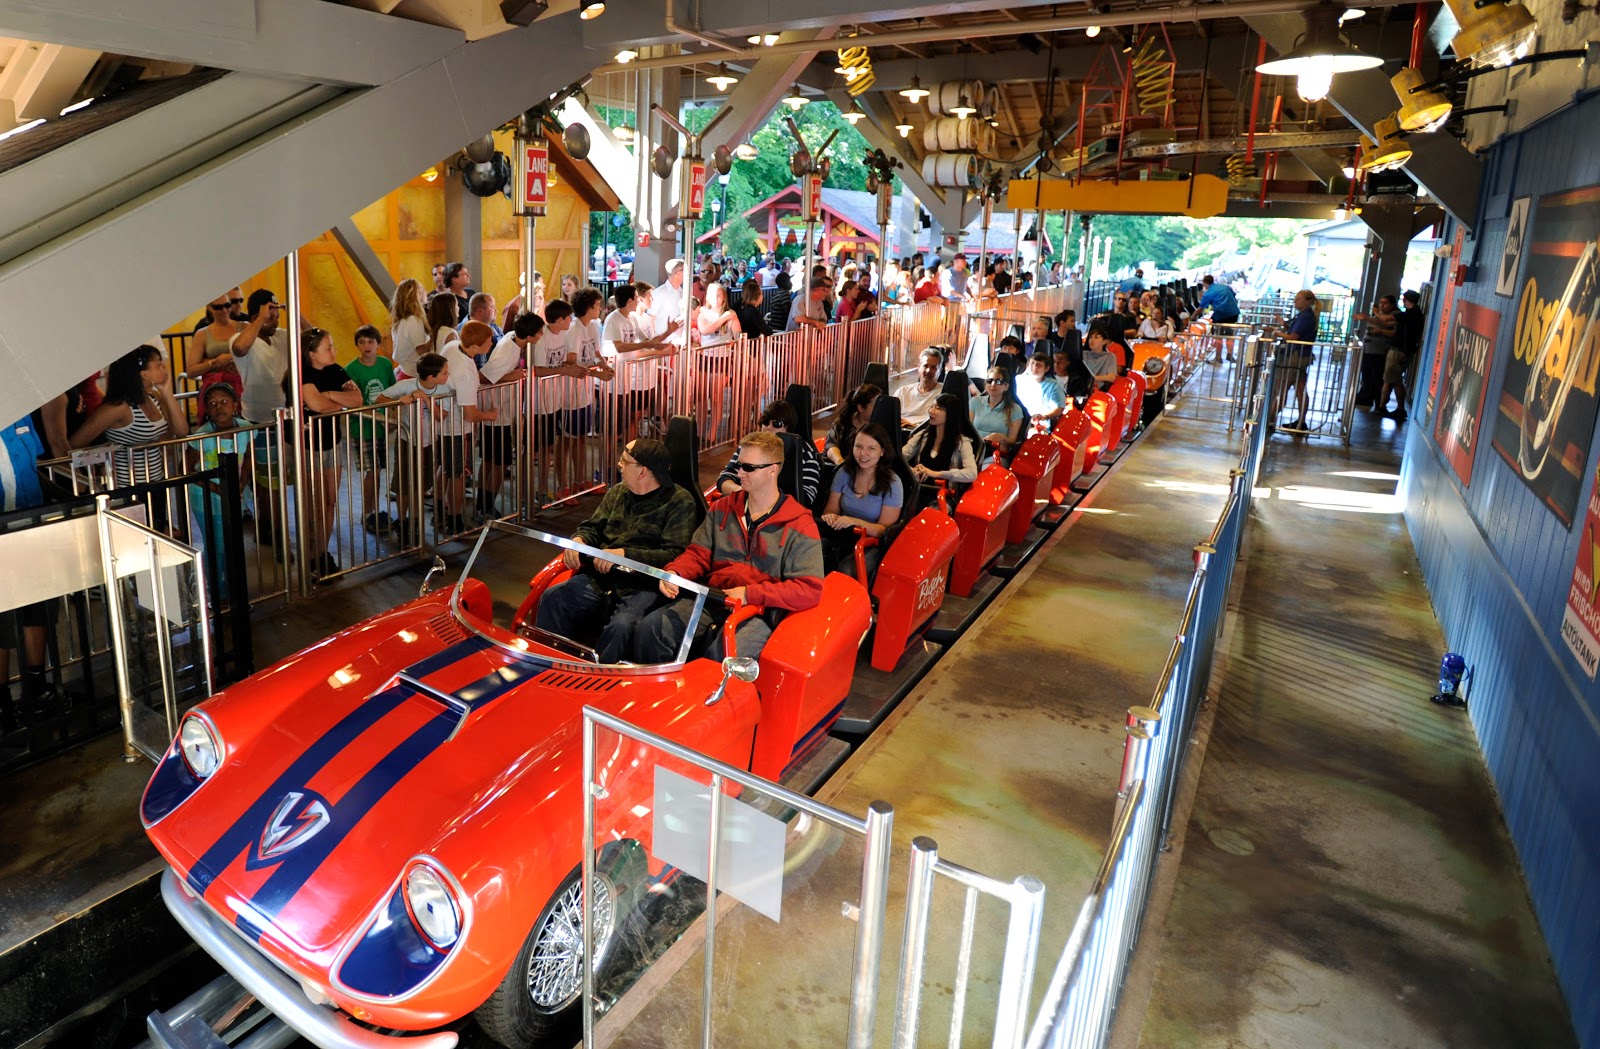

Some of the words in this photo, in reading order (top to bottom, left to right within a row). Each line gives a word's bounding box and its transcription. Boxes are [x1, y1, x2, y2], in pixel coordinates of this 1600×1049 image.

[527, 156, 547, 174] LANE
[530, 178, 544, 196] A
[693, 189, 702, 204] A
[1448, 311, 1490, 377] SPHINX
[1588, 494, 1600, 519] AU
[918, 569, 945, 604] Busch
[1574, 566, 1591, 594] WIRD
[1569, 584, 1600, 639] FRISCHÖ
